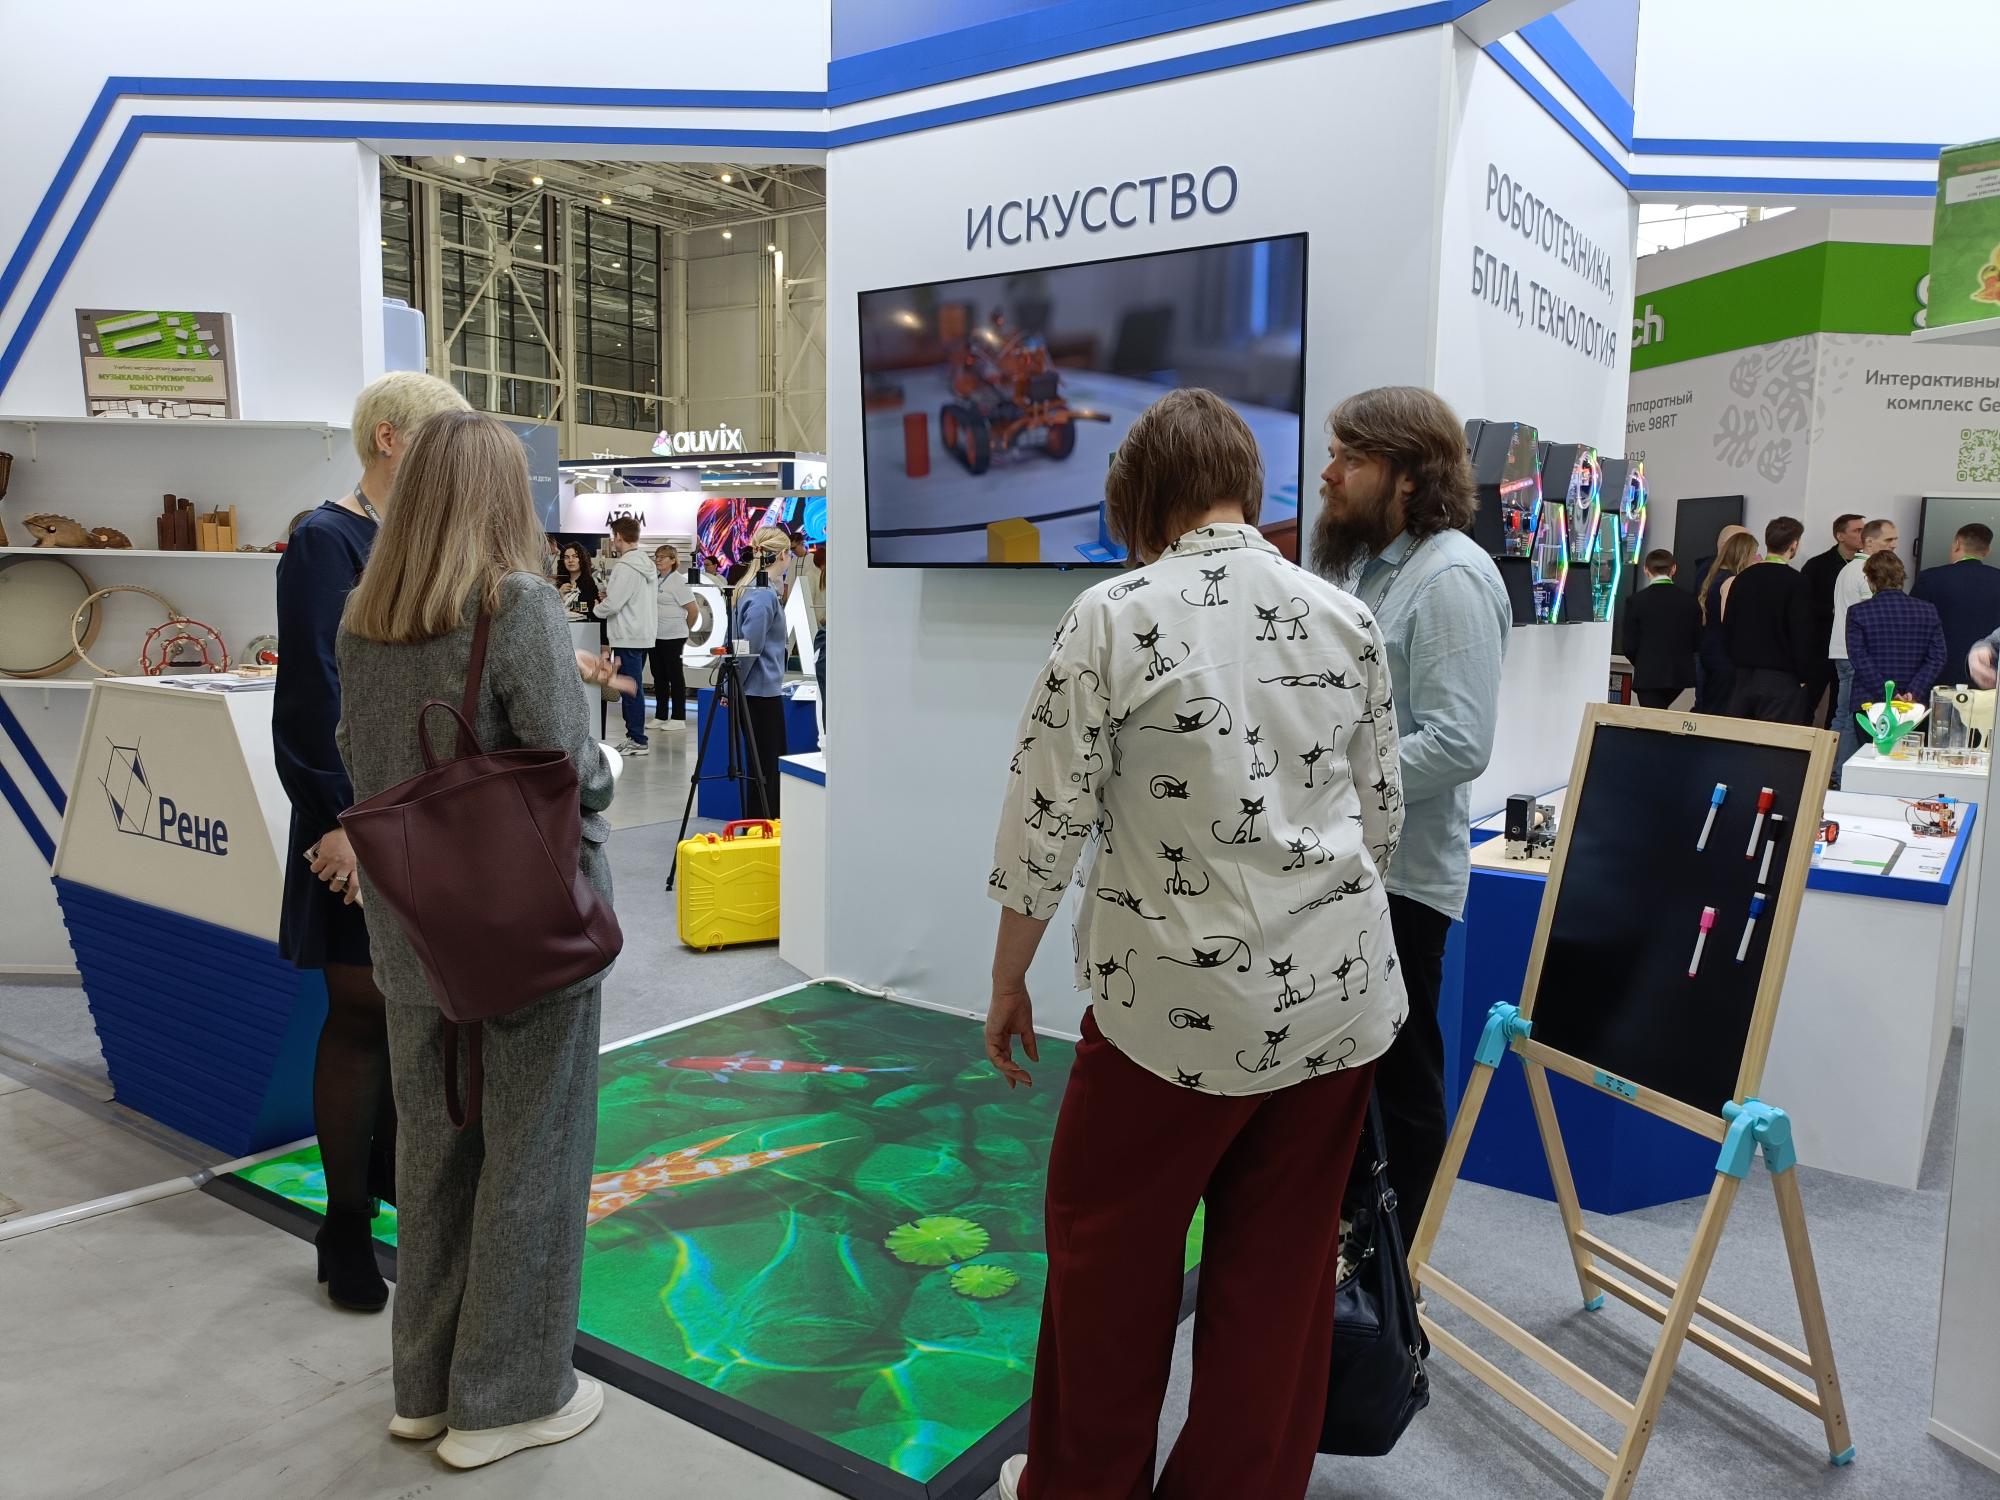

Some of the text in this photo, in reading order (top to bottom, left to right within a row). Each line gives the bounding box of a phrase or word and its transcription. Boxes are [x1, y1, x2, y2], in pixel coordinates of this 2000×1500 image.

[966, 165, 1238, 250] ИСКУССТВО
[1486, 162, 1614, 304] РОБОТОТЕХНИКА,
[1471, 245, 1617, 369] БПЛА, ТЕХНОЛОГИЯ
[129, 384, 185, 392] КОНСТРУКТОР
[1626, 390, 1693, 414] ппаратный
[1887, 398, 1973, 412] комплекс
[1648, 413, 1678, 431] 98RT
[673, 423, 742, 453] auvix
[159, 796, 228, 856] Рене
